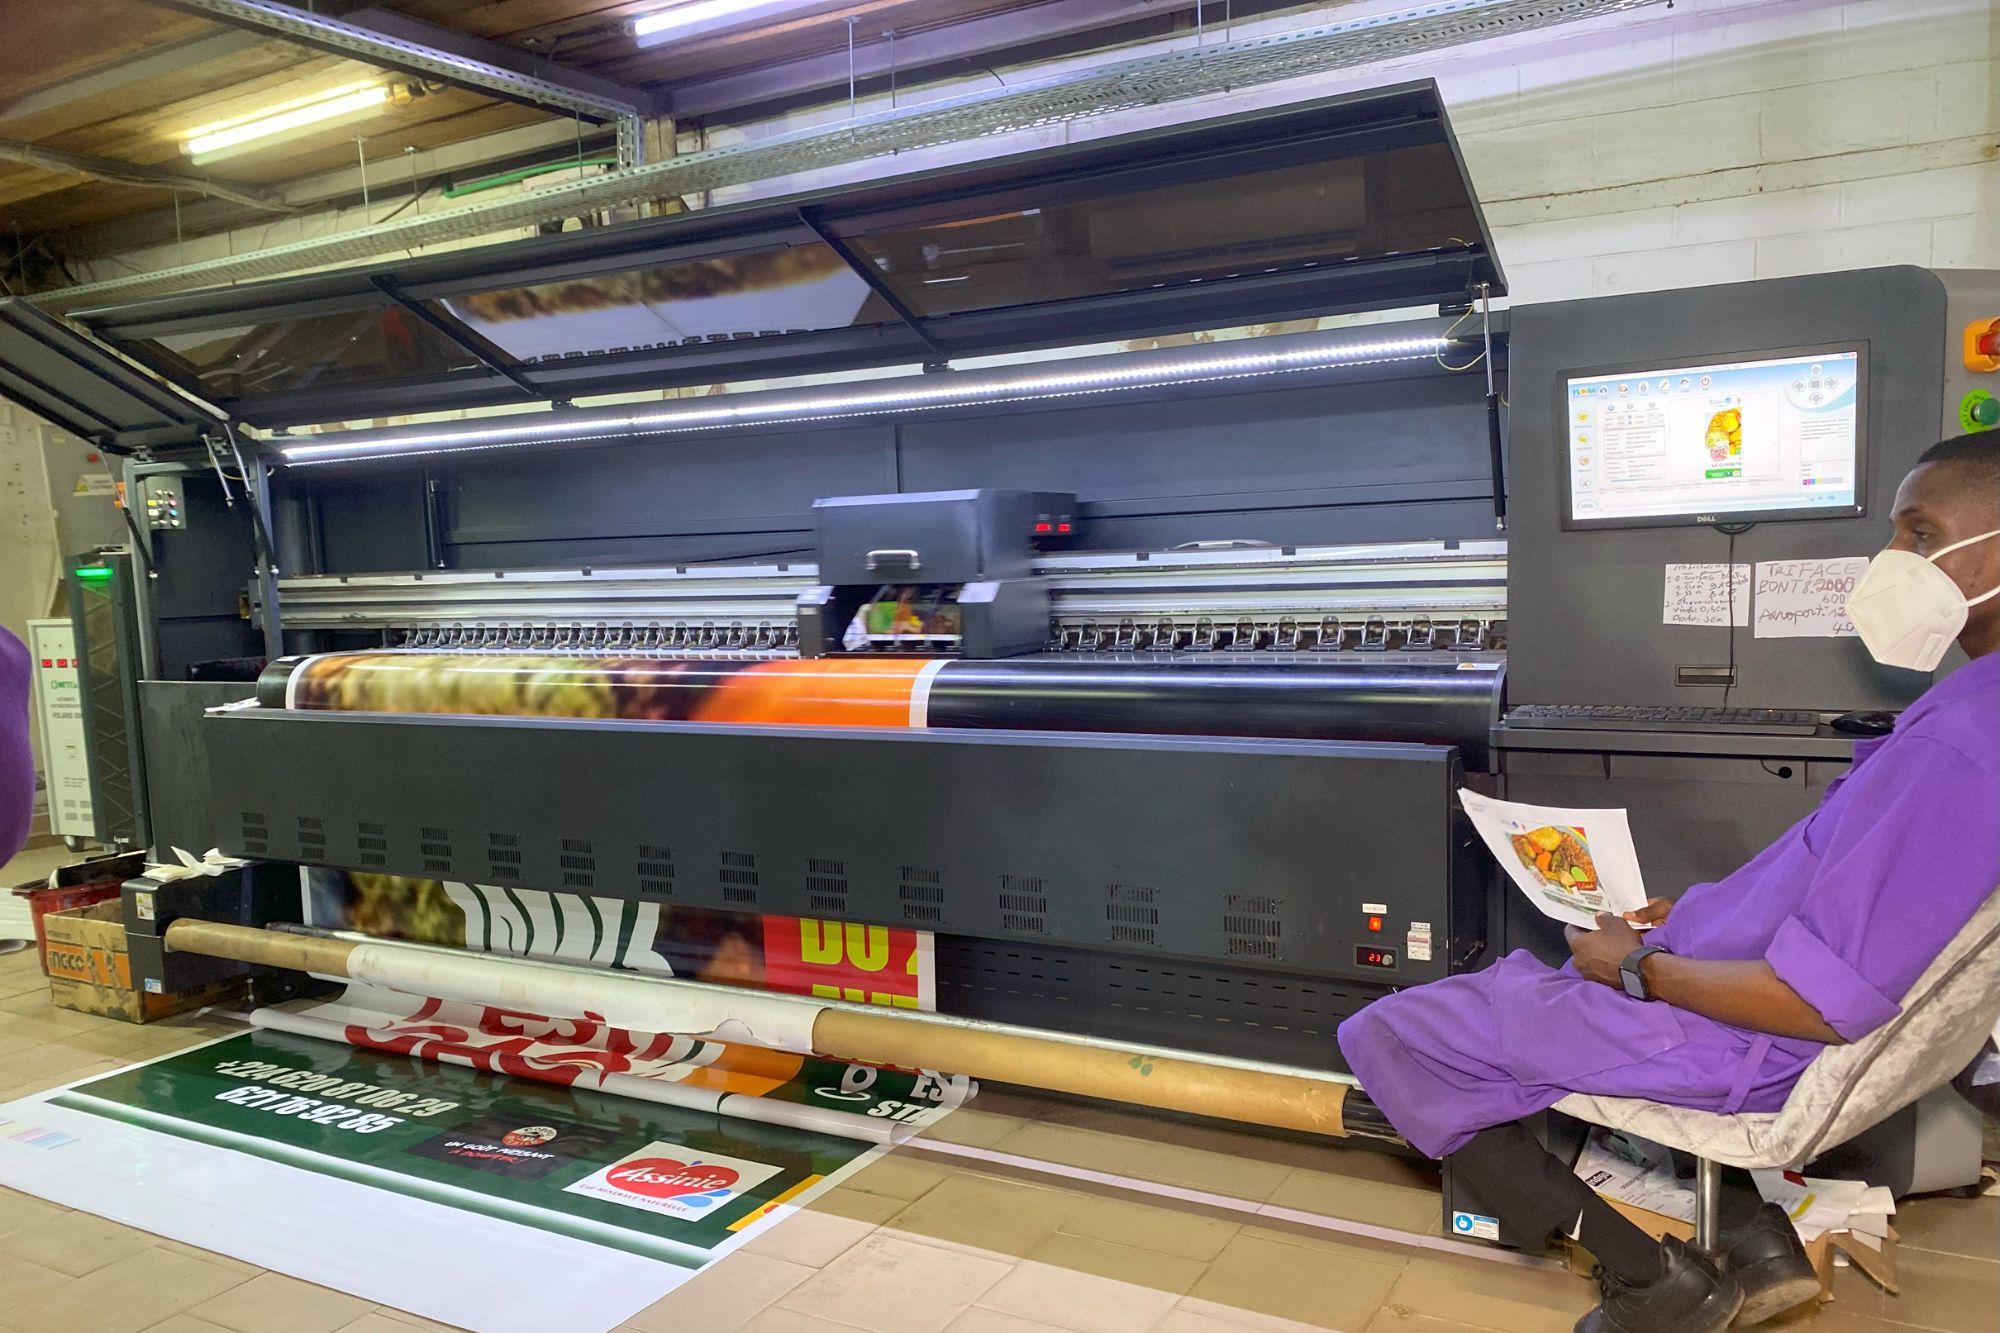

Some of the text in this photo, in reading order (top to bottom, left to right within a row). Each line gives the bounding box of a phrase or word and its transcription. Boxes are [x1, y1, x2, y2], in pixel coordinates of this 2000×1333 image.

[1697, 515, 1717, 523] DELL
[1766, 563, 1860, 578] TRIFACE
[1368, 953, 1381, 962] 23
[214, 1060, 459, 1117] +224 620 87 06 29
[215, 1085, 405, 1134] 621 76 92 85
[611, 1166, 728, 1190] Assinie
